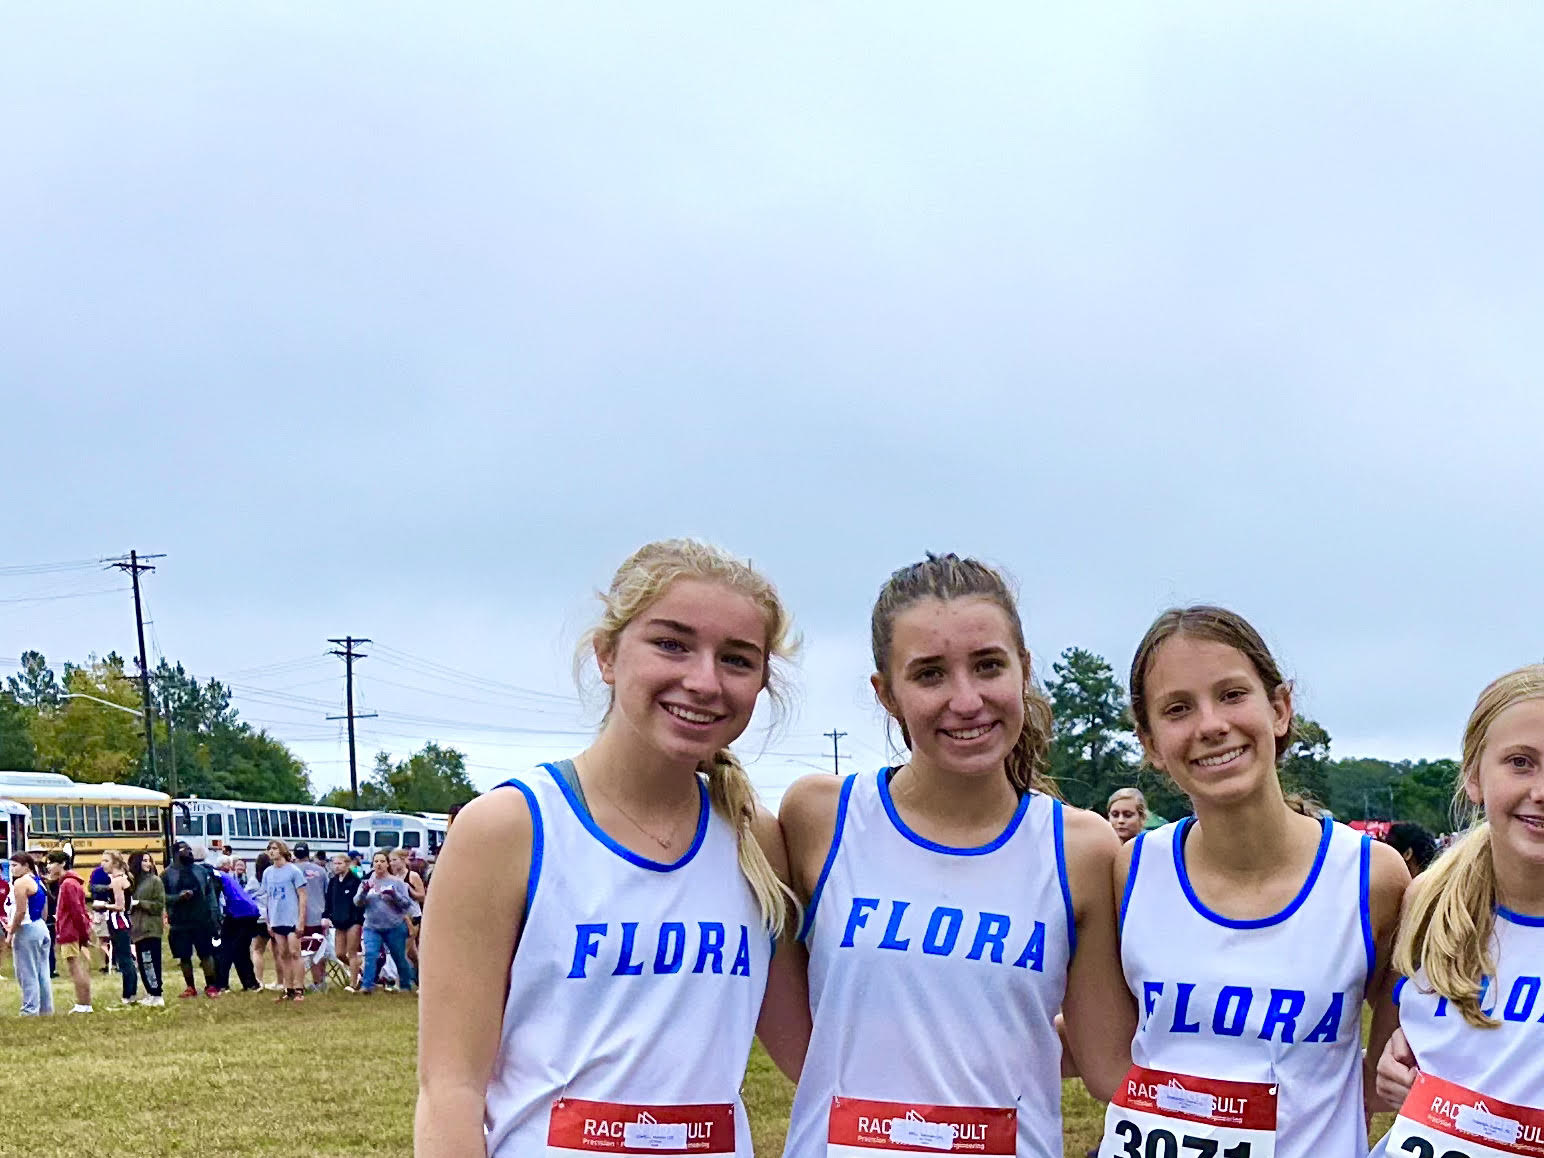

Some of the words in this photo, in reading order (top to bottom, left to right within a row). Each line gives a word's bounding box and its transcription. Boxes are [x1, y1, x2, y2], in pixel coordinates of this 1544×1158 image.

[567, 921, 752, 980] FLORA
[839, 896, 1047, 974] FLORA
[1142, 981, 1345, 1045] FLORA
[1127, 1079, 1157, 1100] RAC
[1211, 1098, 1248, 1115] SULT
[1430, 1096, 1460, 1120] RAC
[583, 1118, 624, 1138] RAC
[857, 1116, 891, 1134] RAC
[953, 1123, 989, 1141] SULT
